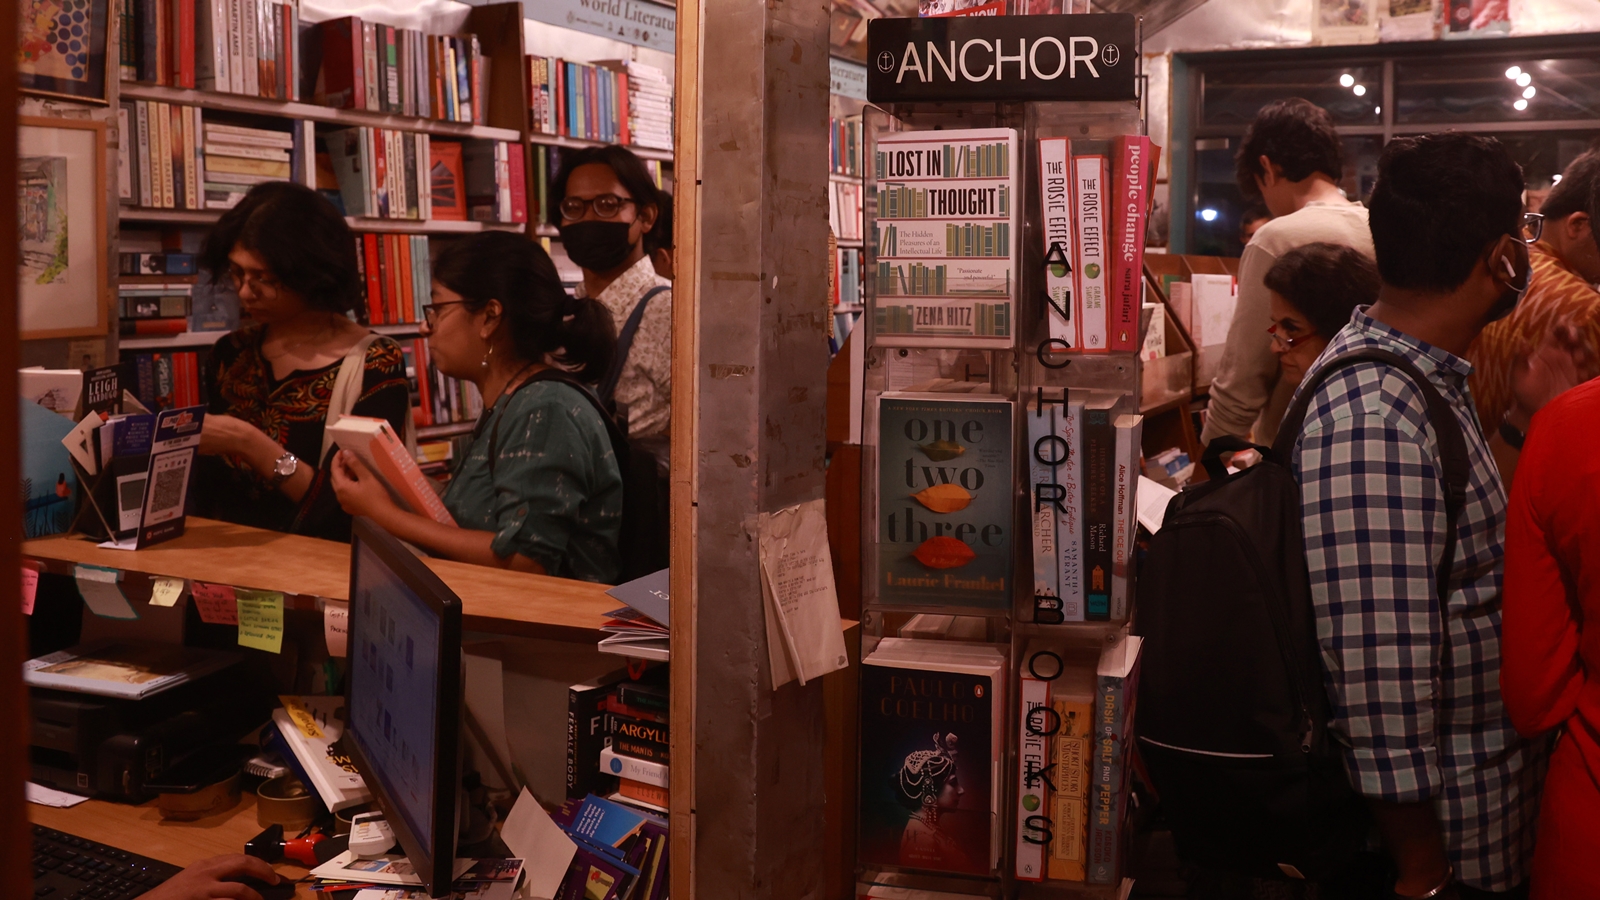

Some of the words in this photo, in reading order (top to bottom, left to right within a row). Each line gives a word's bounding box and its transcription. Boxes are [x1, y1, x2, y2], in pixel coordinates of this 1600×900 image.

[896, 36, 1100, 84] ANCHOR
[888, 150, 923, 177] LOST
[926, 150, 941, 176] IN
[1046, 161, 1063, 175] THE
[1127, 144, 1141, 200] people
[1082, 179, 1097, 190] THE
[928, 188, 996, 215] THOUGHT
[899, 230, 911, 238] The
[912, 230, 934, 238] Hidden
[899, 239, 925, 247] Pleasures
[1083, 226, 1100, 258] EFFECT
[1124, 202, 1141, 262] change
[899, 247, 930, 255] Intellectual
[931, 247, 942, 255] Life
[916, 306, 943, 326] ZENA
[946, 306, 972, 326] HITZ
[1121, 291, 1132, 324] jafari
[89, 377, 118, 396] LEIGH
[903, 418, 984, 443] one
[904, 457, 985, 491] two
[1099, 485, 1105, 497] OF
[887, 507, 1003, 547] three
[1041, 503, 1052, 553] ARCHER
[1098, 522, 1106, 552] Richard
[887, 571, 939, 587] Laurie
[943, 573, 1005, 591] Frankel
[890, 675, 966, 700] PAULO
[880, 696, 974, 723] COELHO
[1104, 695, 1115, 724] DASH
[567, 711, 575, 754] FEMALE
[618, 722, 669, 746] ARGYLL
[1104, 726, 1112, 737] OF
[618, 741, 630, 752] THE
[630, 743, 653, 757] MANTIS
[1102, 738, 1113, 764] SALT
[630, 764, 641, 774] My
[642, 767, 661, 779] Friend
[1103, 766, 1111, 782] AND
[576, 817, 585, 832] more
[584, 804, 592, 817] than
[1099, 785, 1112, 825] PEPPER
[1094, 827, 1103, 864] JACKSON
[1104, 829, 1113, 863] KOSOKO
